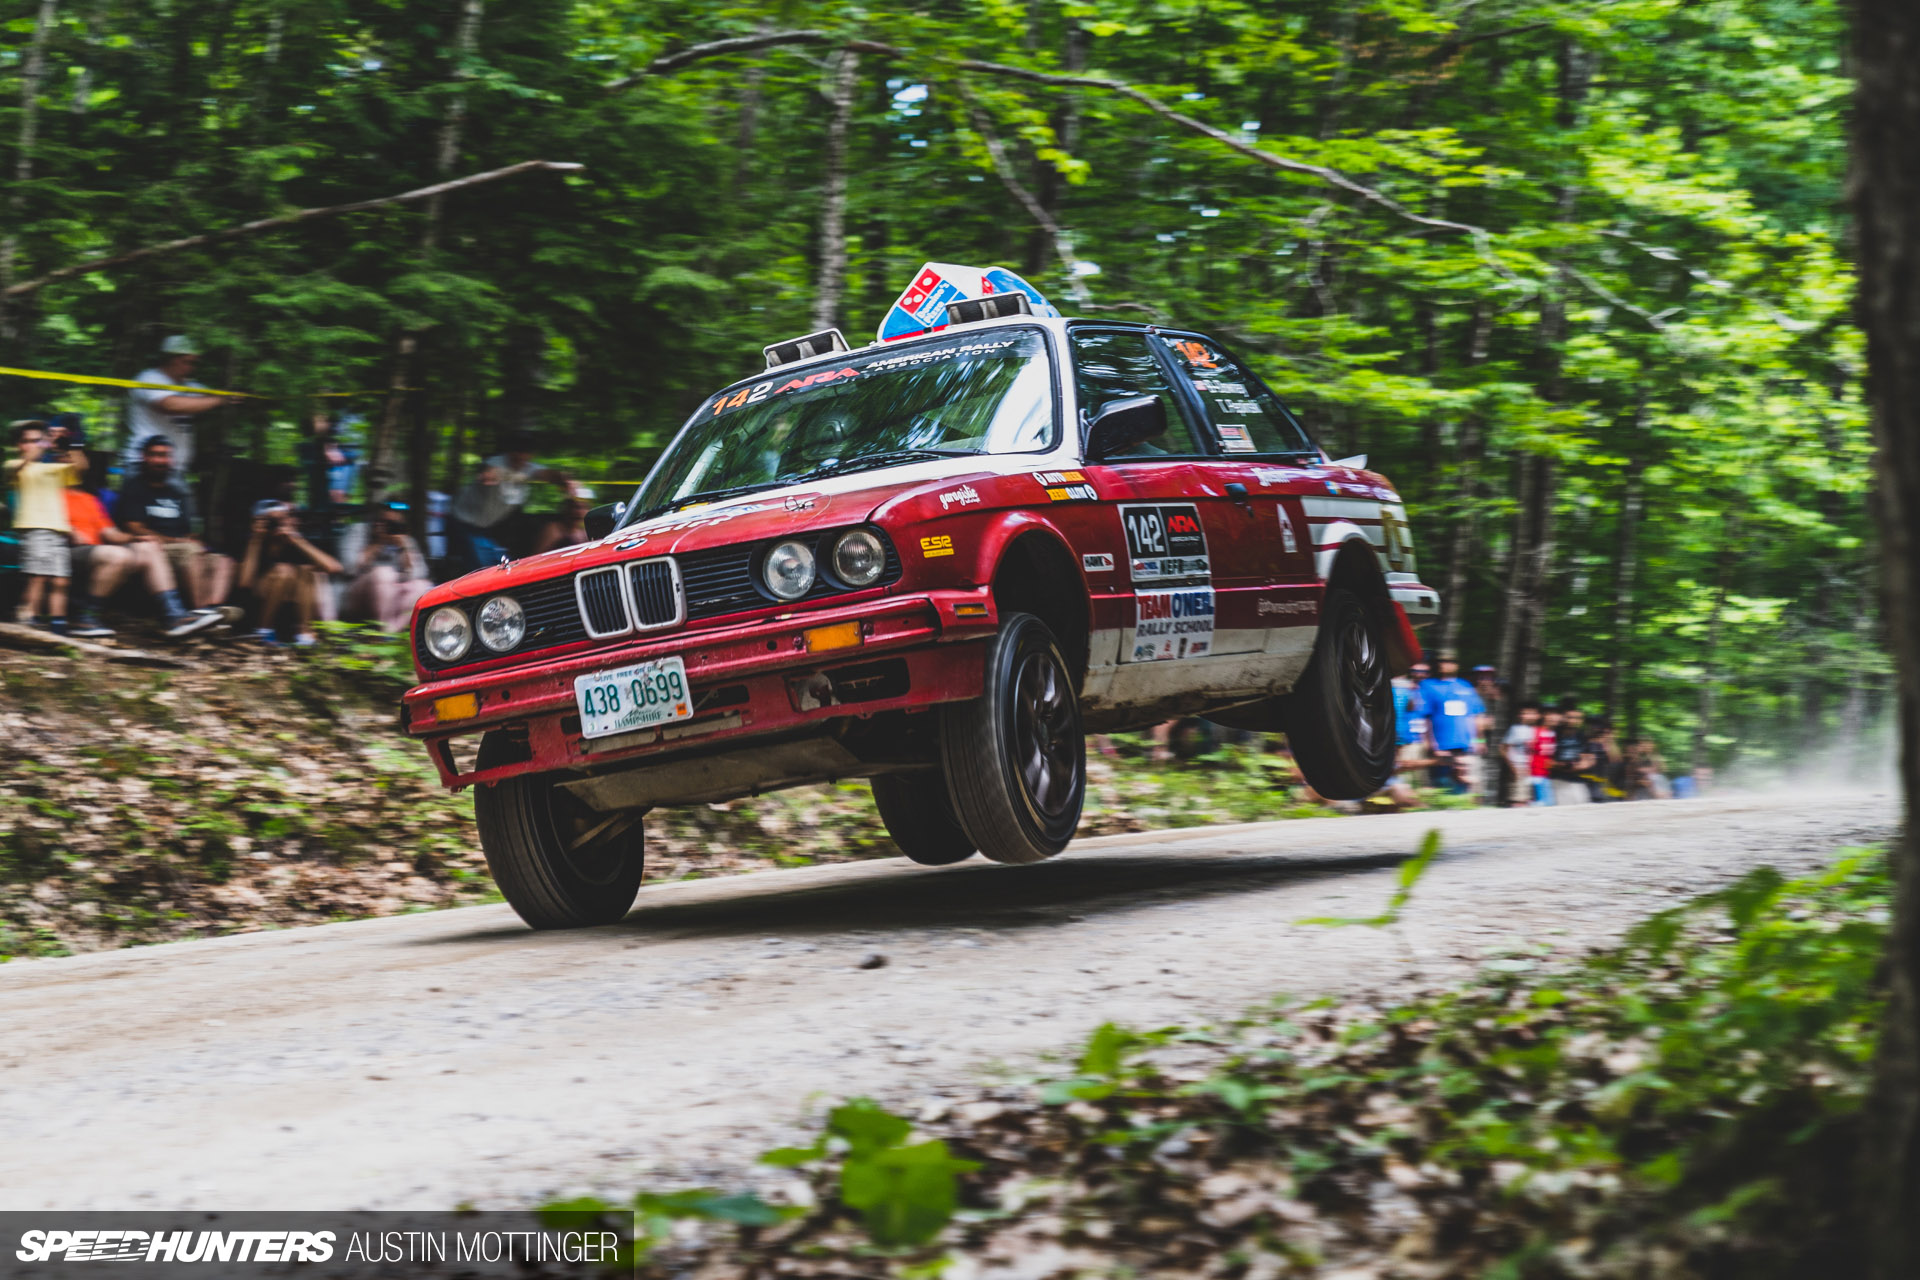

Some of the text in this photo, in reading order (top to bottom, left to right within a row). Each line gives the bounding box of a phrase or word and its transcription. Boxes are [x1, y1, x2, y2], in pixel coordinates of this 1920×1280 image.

[916, 282, 950, 319] Domino's
[865, 341, 1015, 370] AMERICAN RALLY
[874, 348, 996, 372] ASSOCIATION
[712, 381, 774, 416] 142
[1128, 514, 1165, 554] 142
[1168, 515, 1200, 533] ARA
[920, 535, 953, 550] ESR
[1137, 594, 1171, 621] TEAM
[1136, 619, 1213, 637] RALLY SCHOOL
[584, 671, 684, 718] 438 0699
